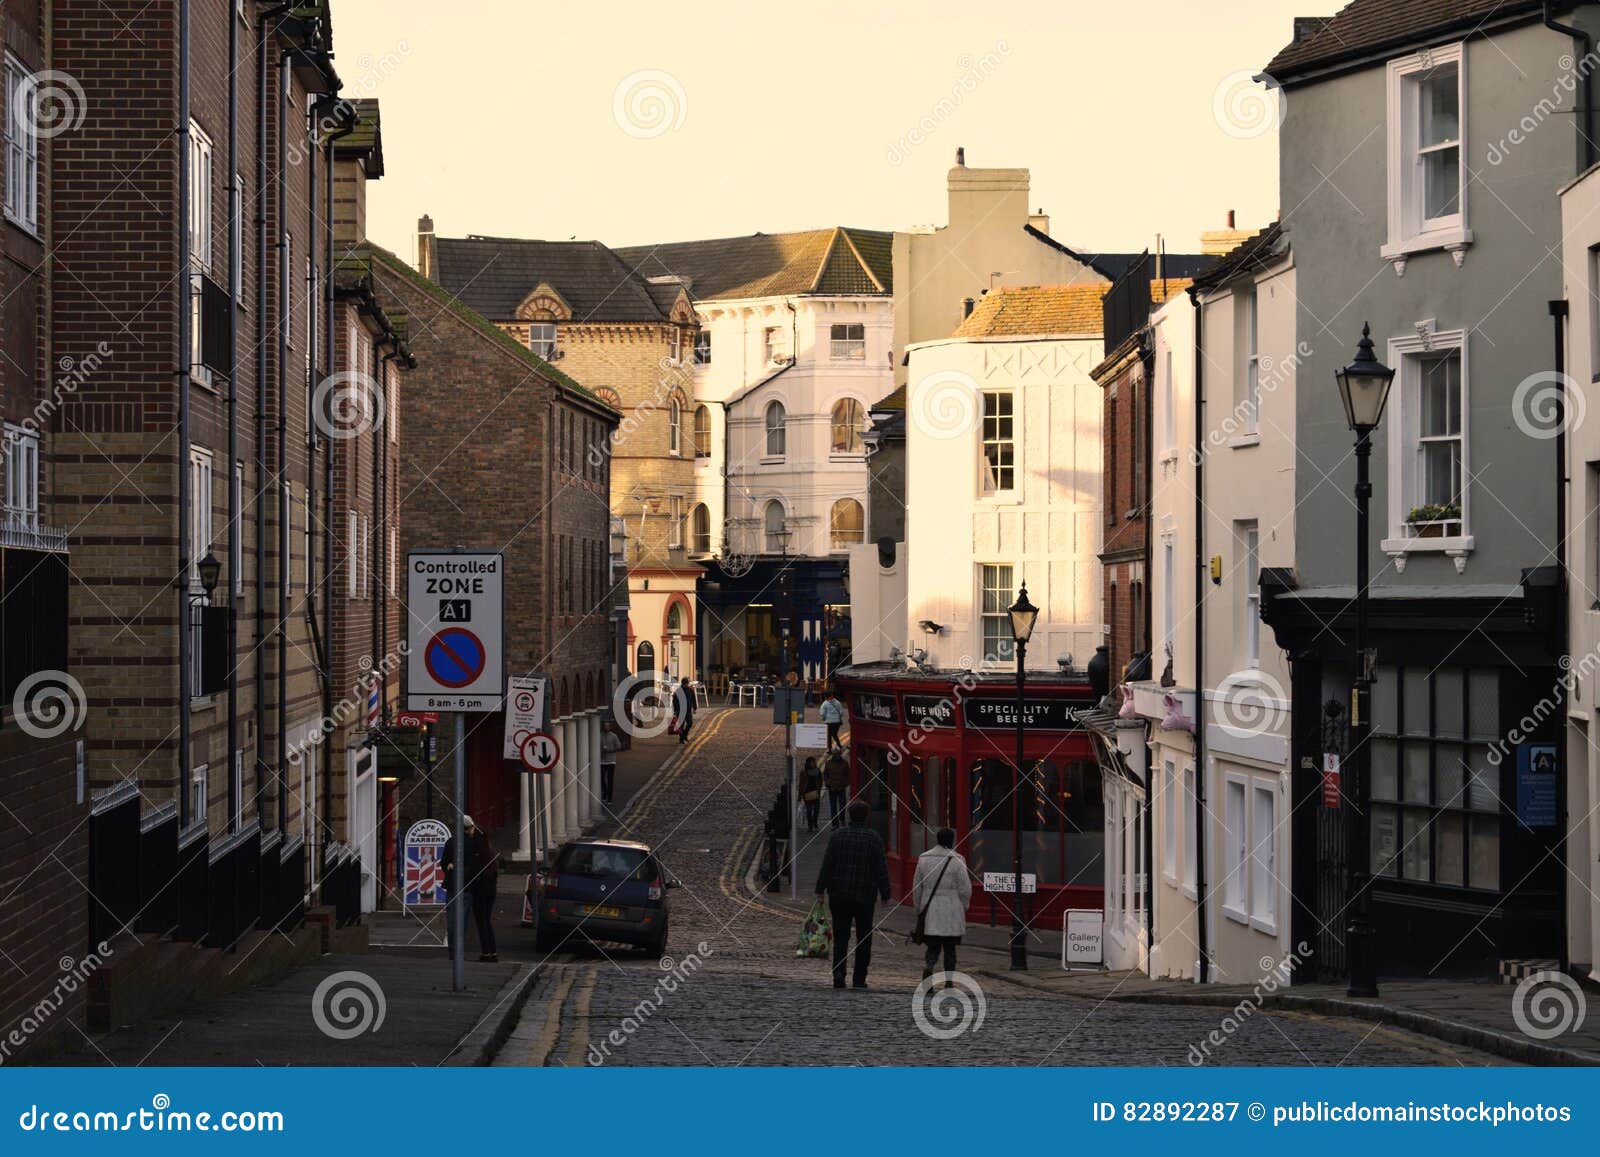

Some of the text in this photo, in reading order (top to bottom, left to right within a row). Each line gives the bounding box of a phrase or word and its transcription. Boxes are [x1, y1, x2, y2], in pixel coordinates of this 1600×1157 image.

[414, 560, 497, 574] Controlled
[426, 578, 484, 594] ZONE
[443, 604, 466, 619] A1
[428, 698, 435, 707] 8
[459, 698, 465, 707] 6
[467, 700, 482, 708] pm
[911, 705, 927, 716] FINE
[980, 705, 1050, 714] SPECILITY
[994, 876, 1026, 884] THE OD
[985, 883, 1034, 892] HIGH STEET
[1069, 933, 1100, 944] Gallery
[1072, 944, 1097, 953] Open
